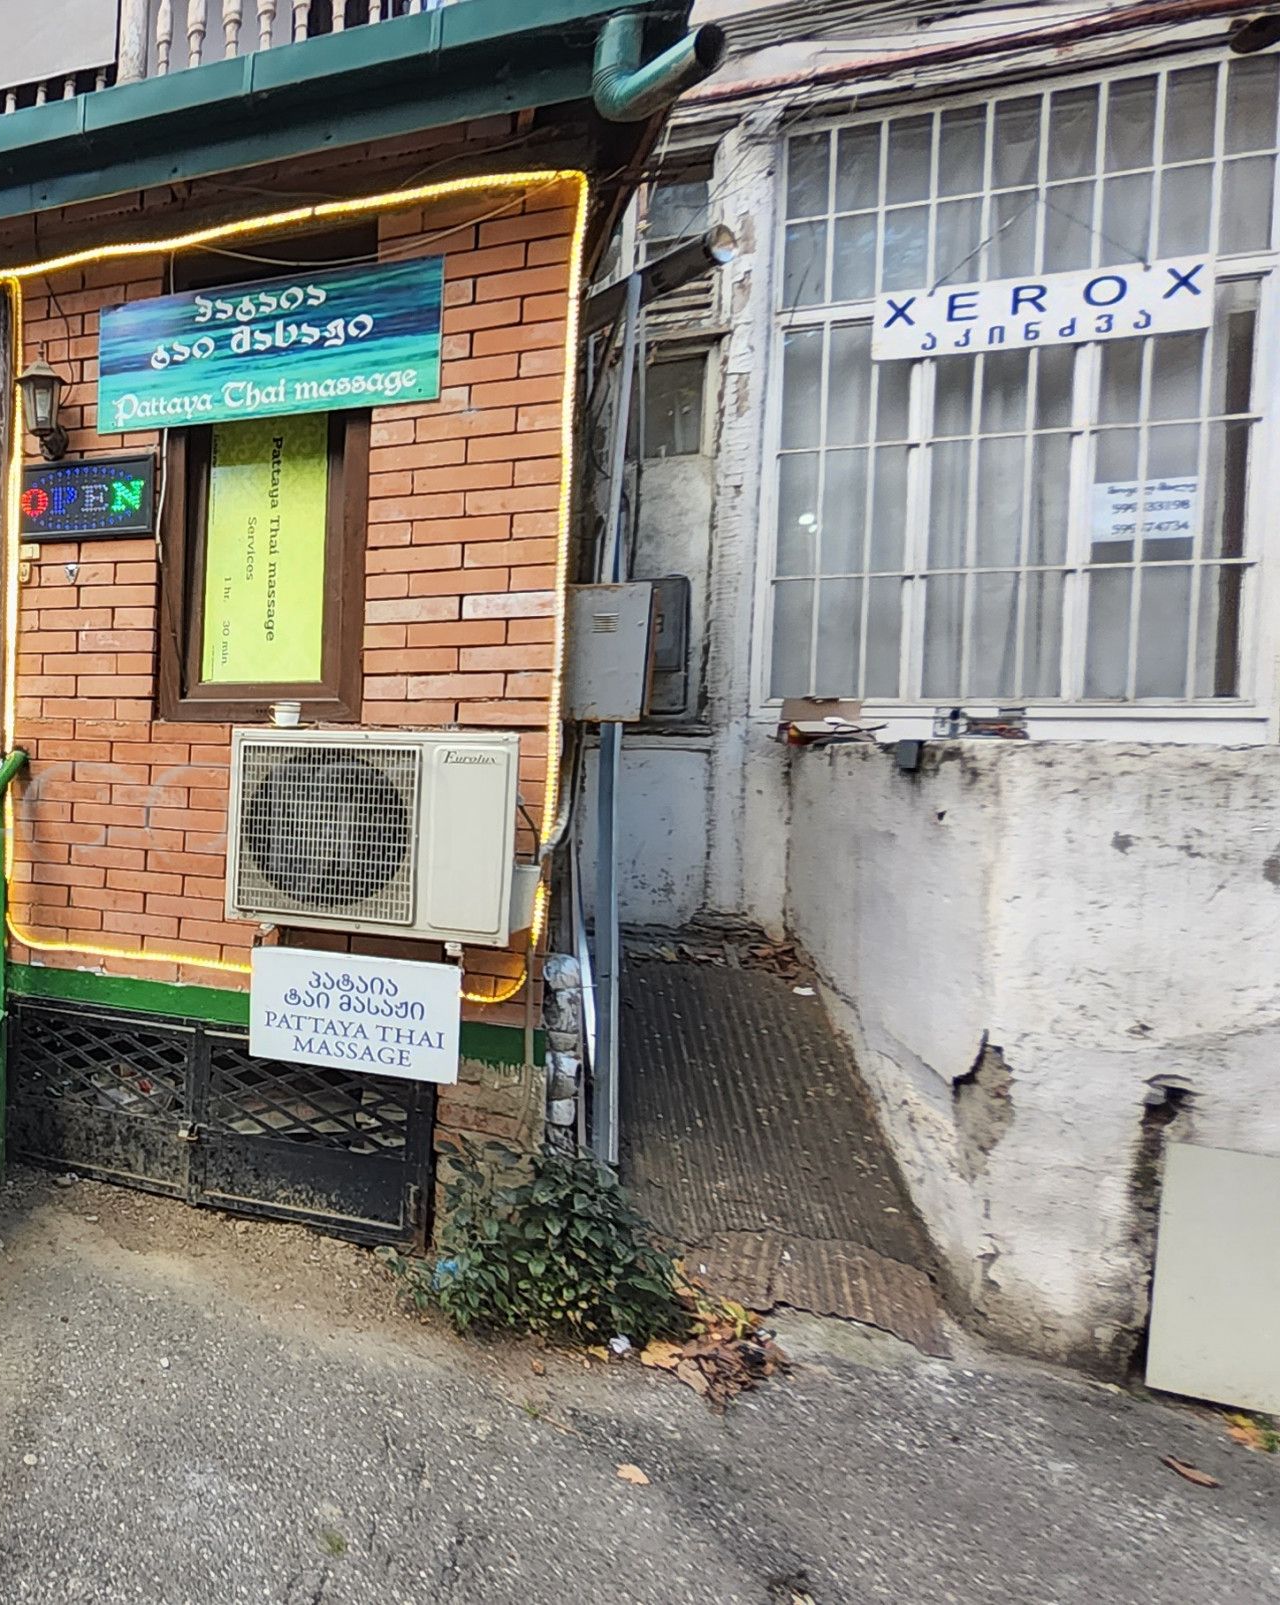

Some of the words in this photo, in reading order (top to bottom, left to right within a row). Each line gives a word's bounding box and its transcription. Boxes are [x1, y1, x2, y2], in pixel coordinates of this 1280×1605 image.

[194, 284, 327, 323] პატაია
[883, 263, 1204, 329] XEROX
[150, 336, 215, 369] ტაი
[230, 314, 374, 354] მასაჟი
[920, 309, 1152, 351] აკინძვა
[112, 391, 213, 427] Pattaya
[221, 378, 286, 411] Thai
[294, 368, 418, 402] massage
[269, 436, 283, 509] Pattaya
[20, 480, 145, 518] OPEN
[245, 516, 257, 581] Services
[269, 515, 281, 556] Thai
[264, 562, 277, 642] massage
[222, 621, 230, 637] 30
[442, 750, 497, 764] Eurolux
[308, 970, 399, 997] პატაია
[284, 988, 330, 1010] ტაი
[339, 994, 426, 1021] მასაჟი
[264, 1010, 370, 1040] PATTAYA
[375, 1024, 446, 1050] THAI
[293, 1035, 413, 1067] MASSAGE
